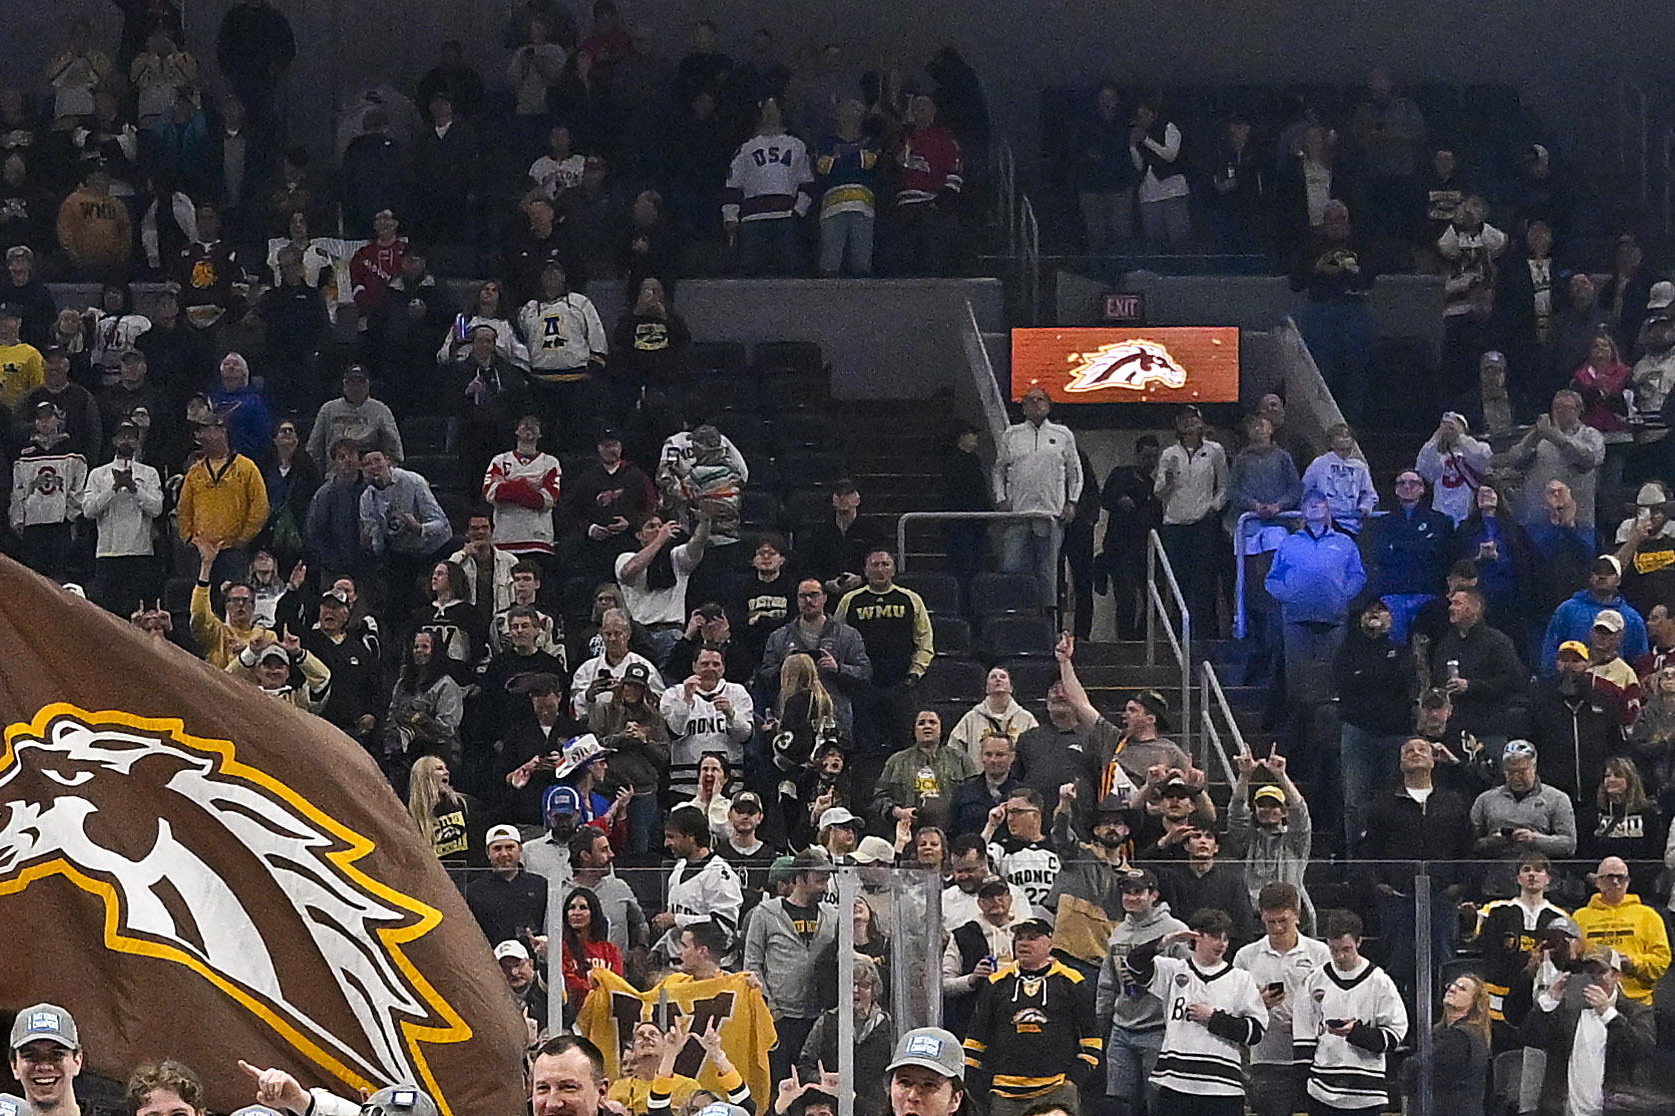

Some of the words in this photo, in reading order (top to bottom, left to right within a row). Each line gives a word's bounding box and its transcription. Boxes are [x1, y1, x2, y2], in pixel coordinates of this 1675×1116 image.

[751, 146, 793, 169] USA
[1106, 296, 1136, 317] EXIT
[856, 606, 906, 621] WMU
